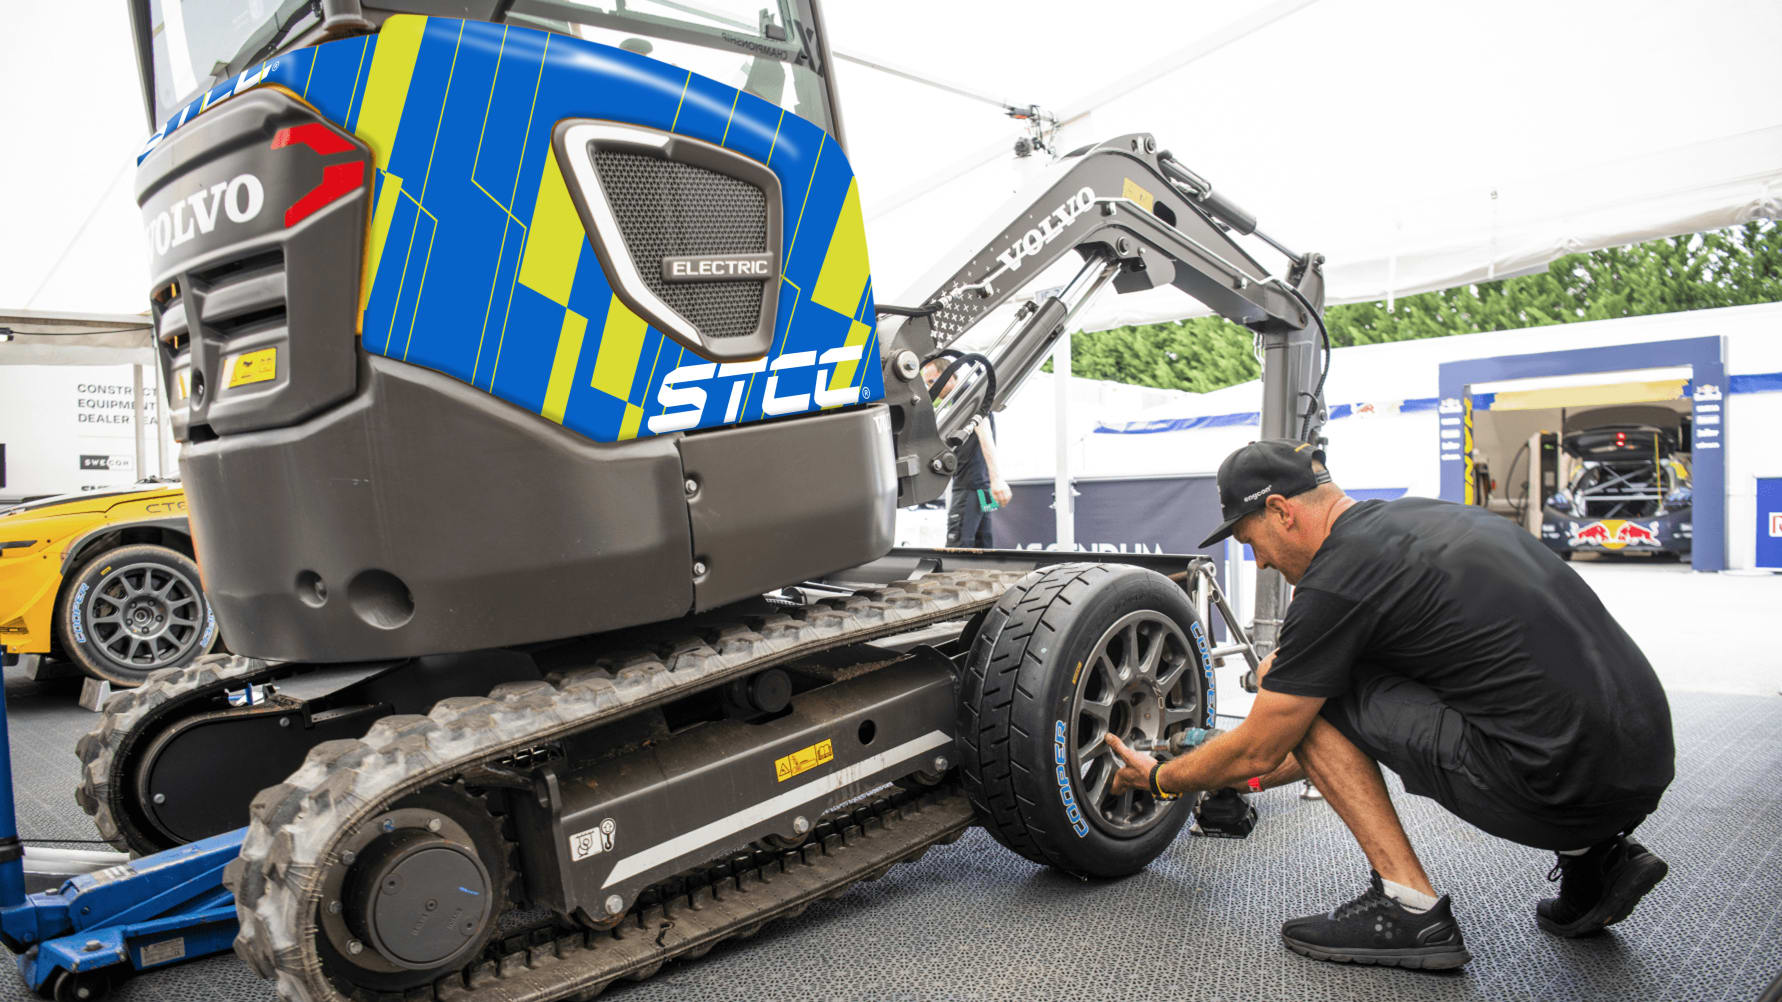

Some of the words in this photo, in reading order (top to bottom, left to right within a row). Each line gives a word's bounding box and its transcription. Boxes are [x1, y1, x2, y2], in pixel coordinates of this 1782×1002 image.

[996, 186, 1096, 271] VOLVO
[672, 260, 769, 276] ELECTRIC
[77, 383, 158, 397] CONSTRCT
[78, 413, 130, 424] DEALER
[72, 582, 90, 643] COOPER
[1190, 620, 1217, 728] COOPER
[1054, 719, 1089, 838] COOPER
